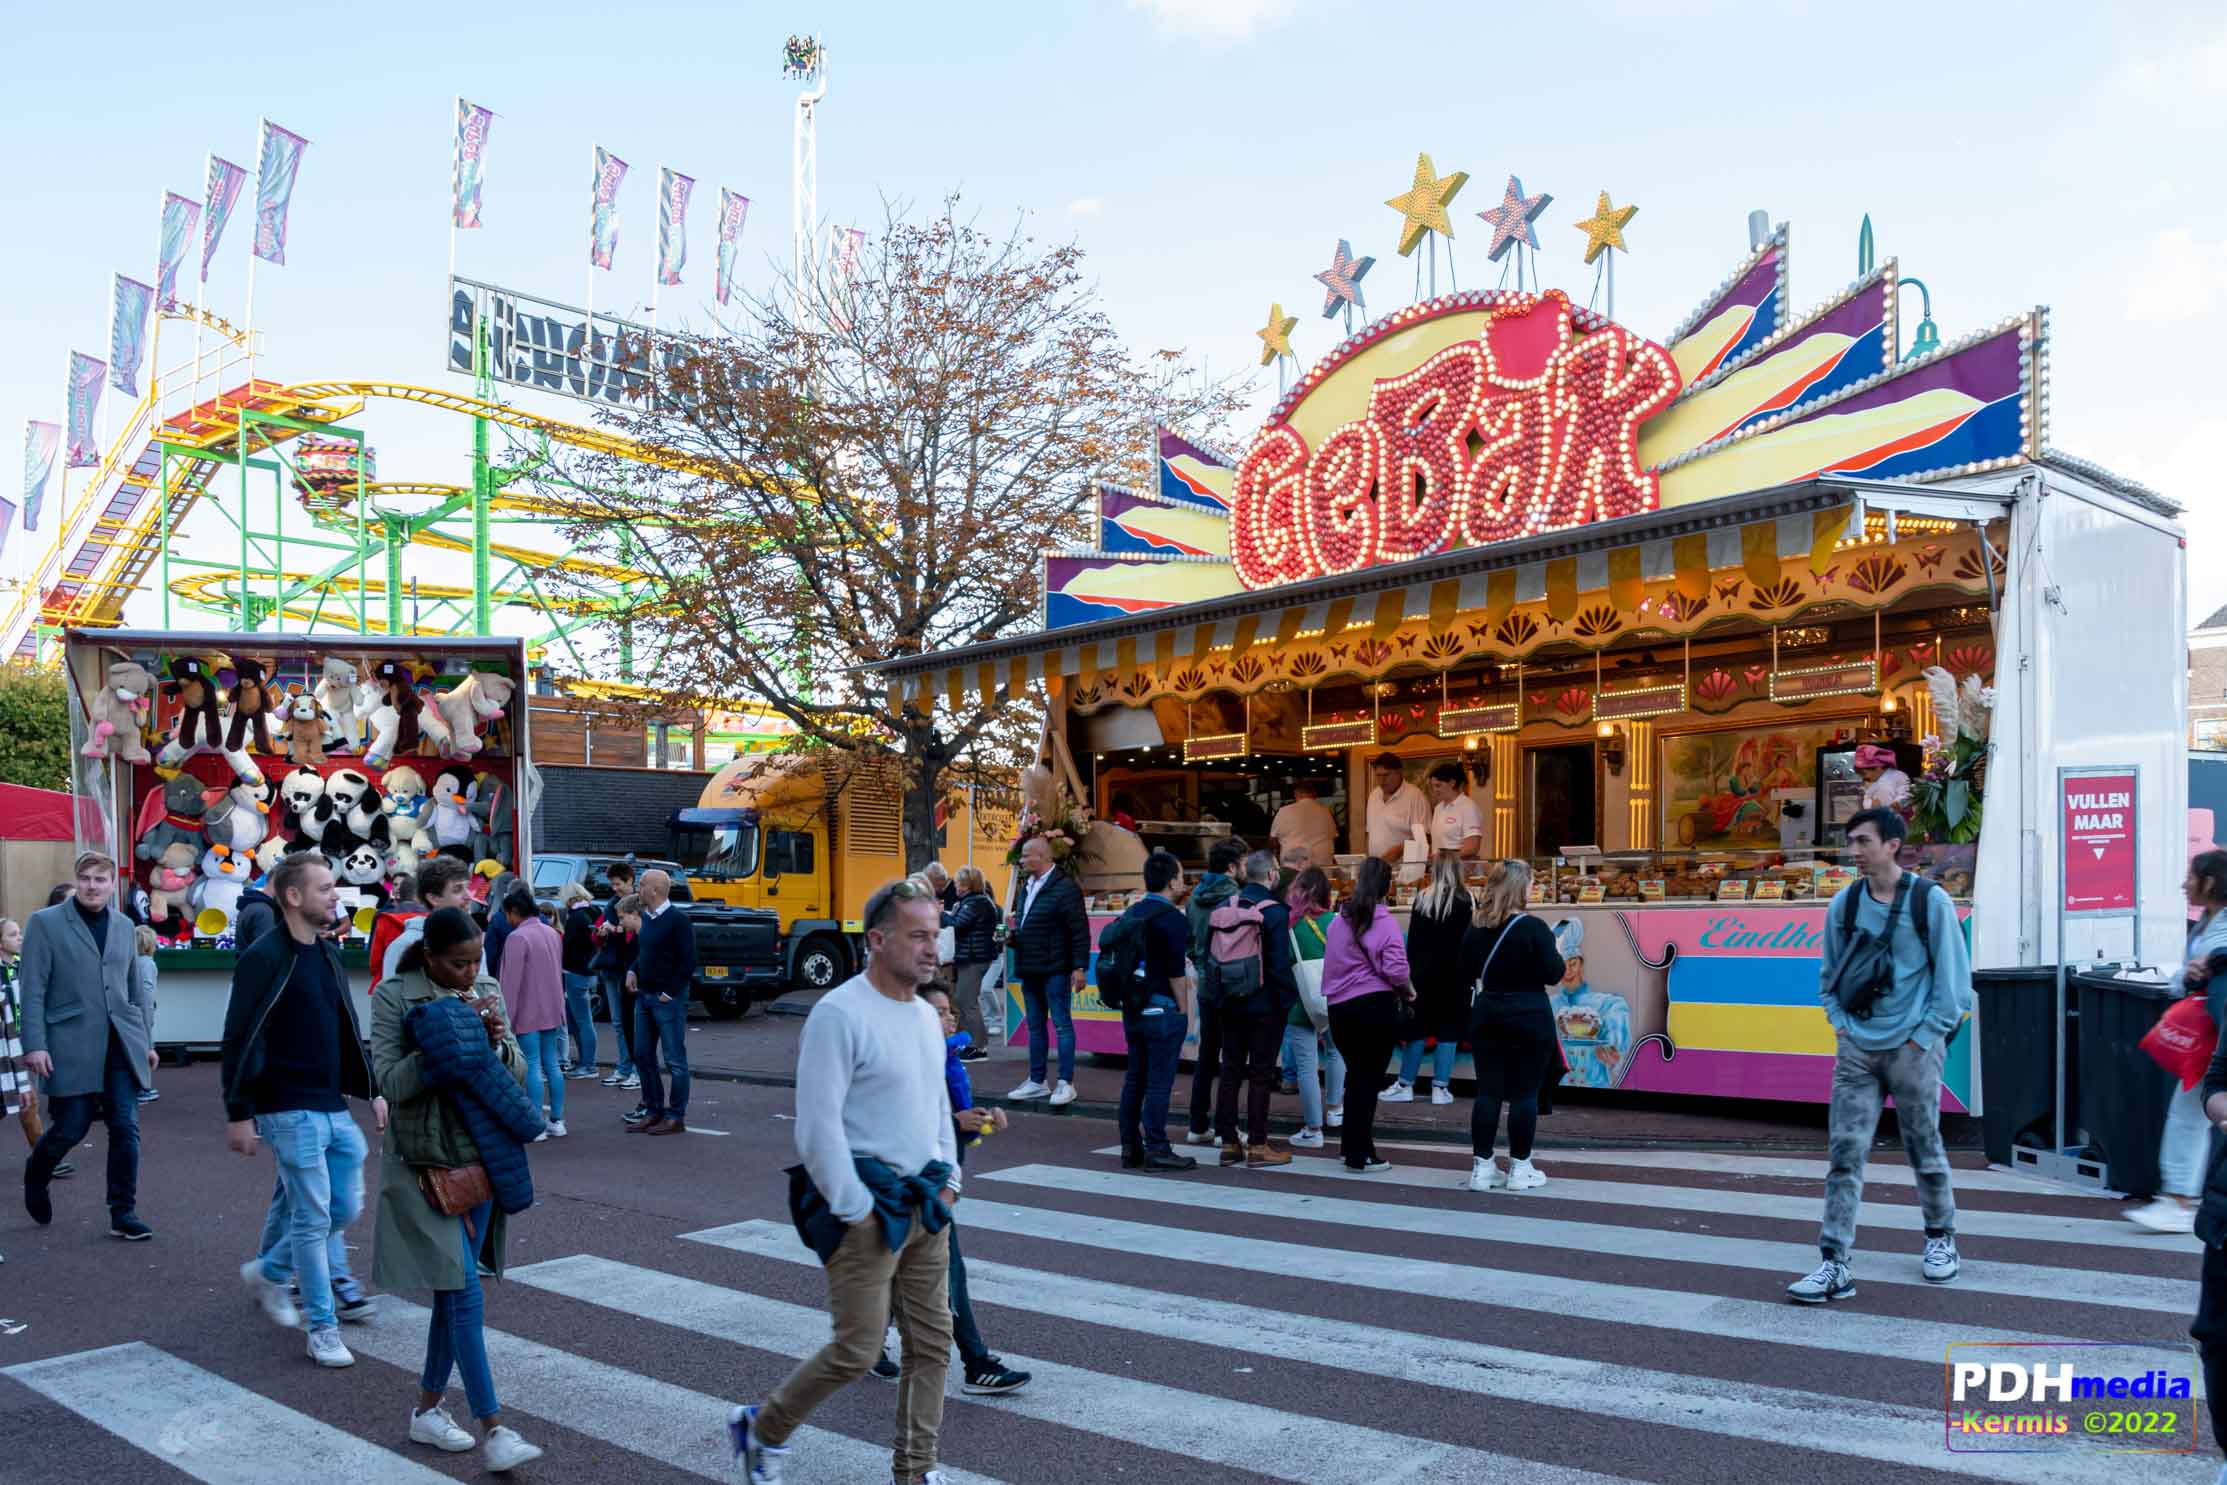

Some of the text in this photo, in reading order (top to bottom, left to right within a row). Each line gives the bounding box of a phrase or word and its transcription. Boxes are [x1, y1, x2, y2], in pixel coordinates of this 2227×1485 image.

[2067, 793, 2130, 809] VULLEN
[2074, 814, 2123, 830] MAAR
[1699, 916, 1825, 950] Eindho
